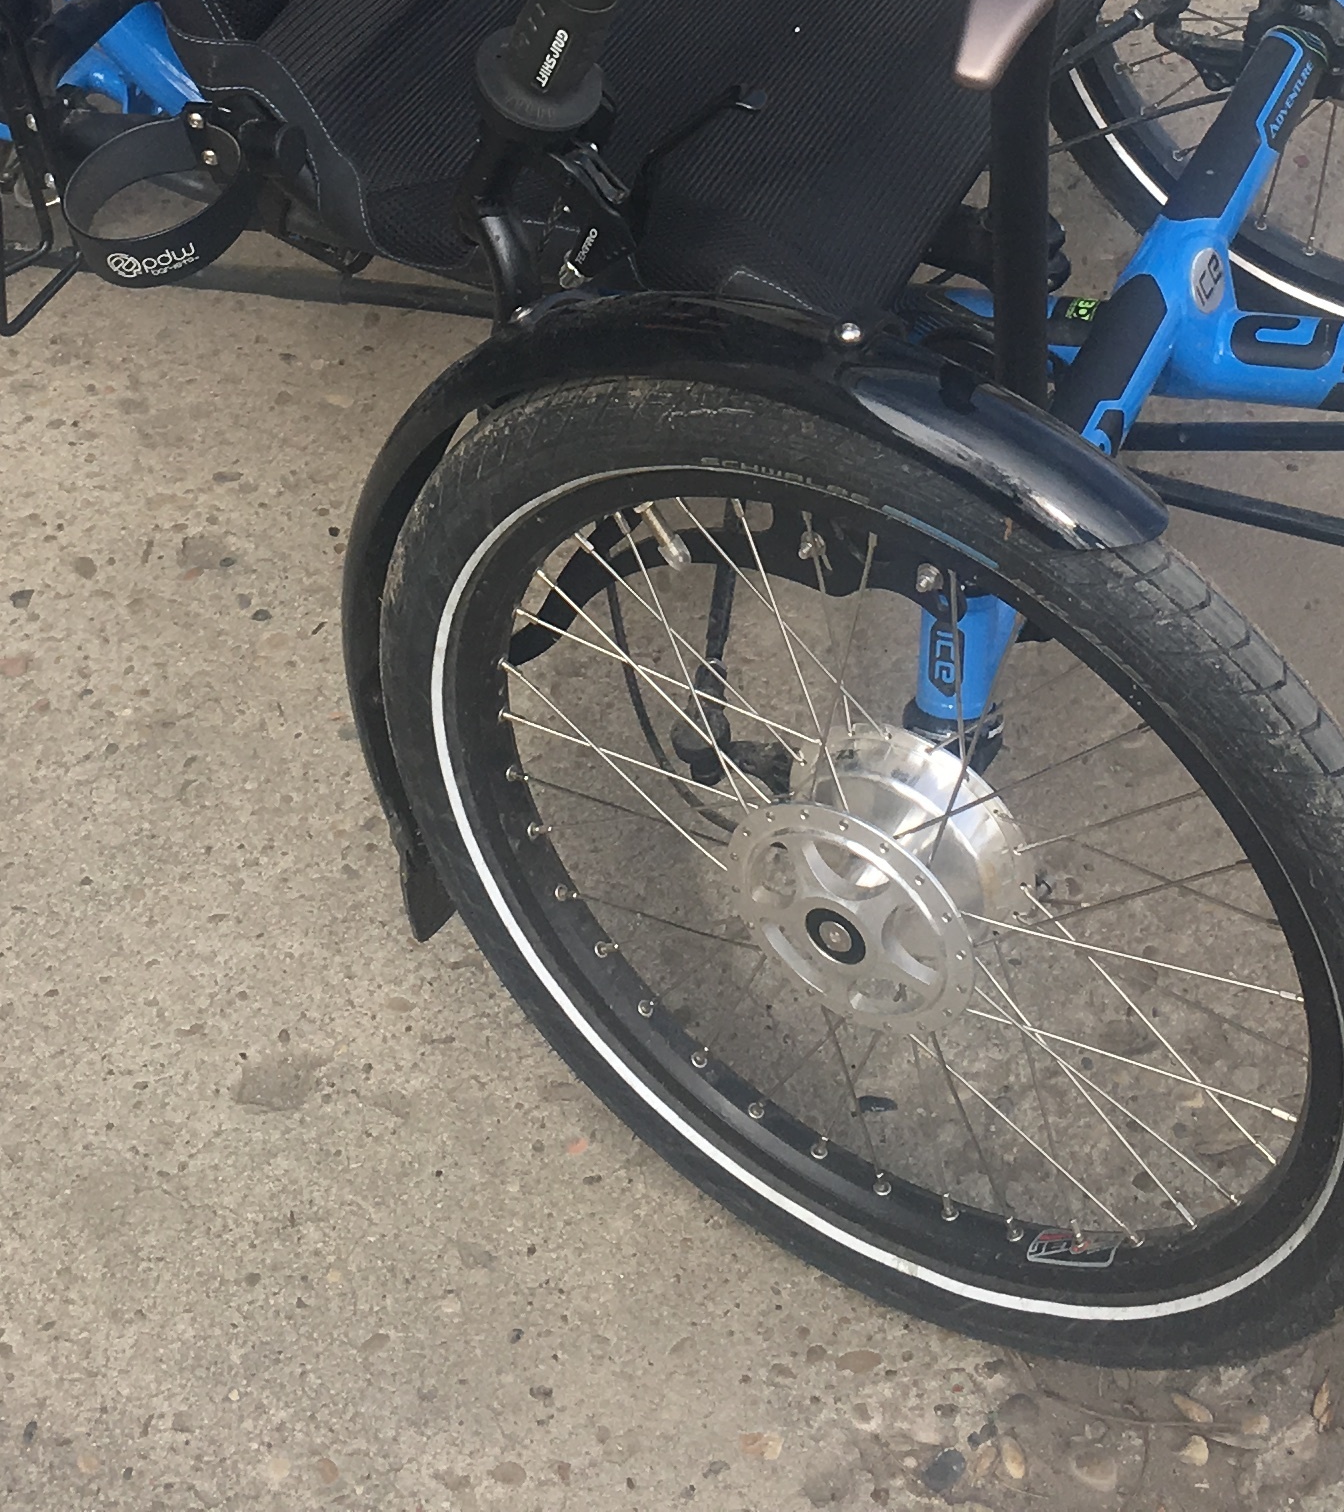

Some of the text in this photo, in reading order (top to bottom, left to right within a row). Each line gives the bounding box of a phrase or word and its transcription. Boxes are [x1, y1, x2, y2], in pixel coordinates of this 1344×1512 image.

[1269, 59, 1315, 140] ADVENTURE
[141, 242, 196, 274] pdw
[574, 228, 598, 265] TEKTRO
